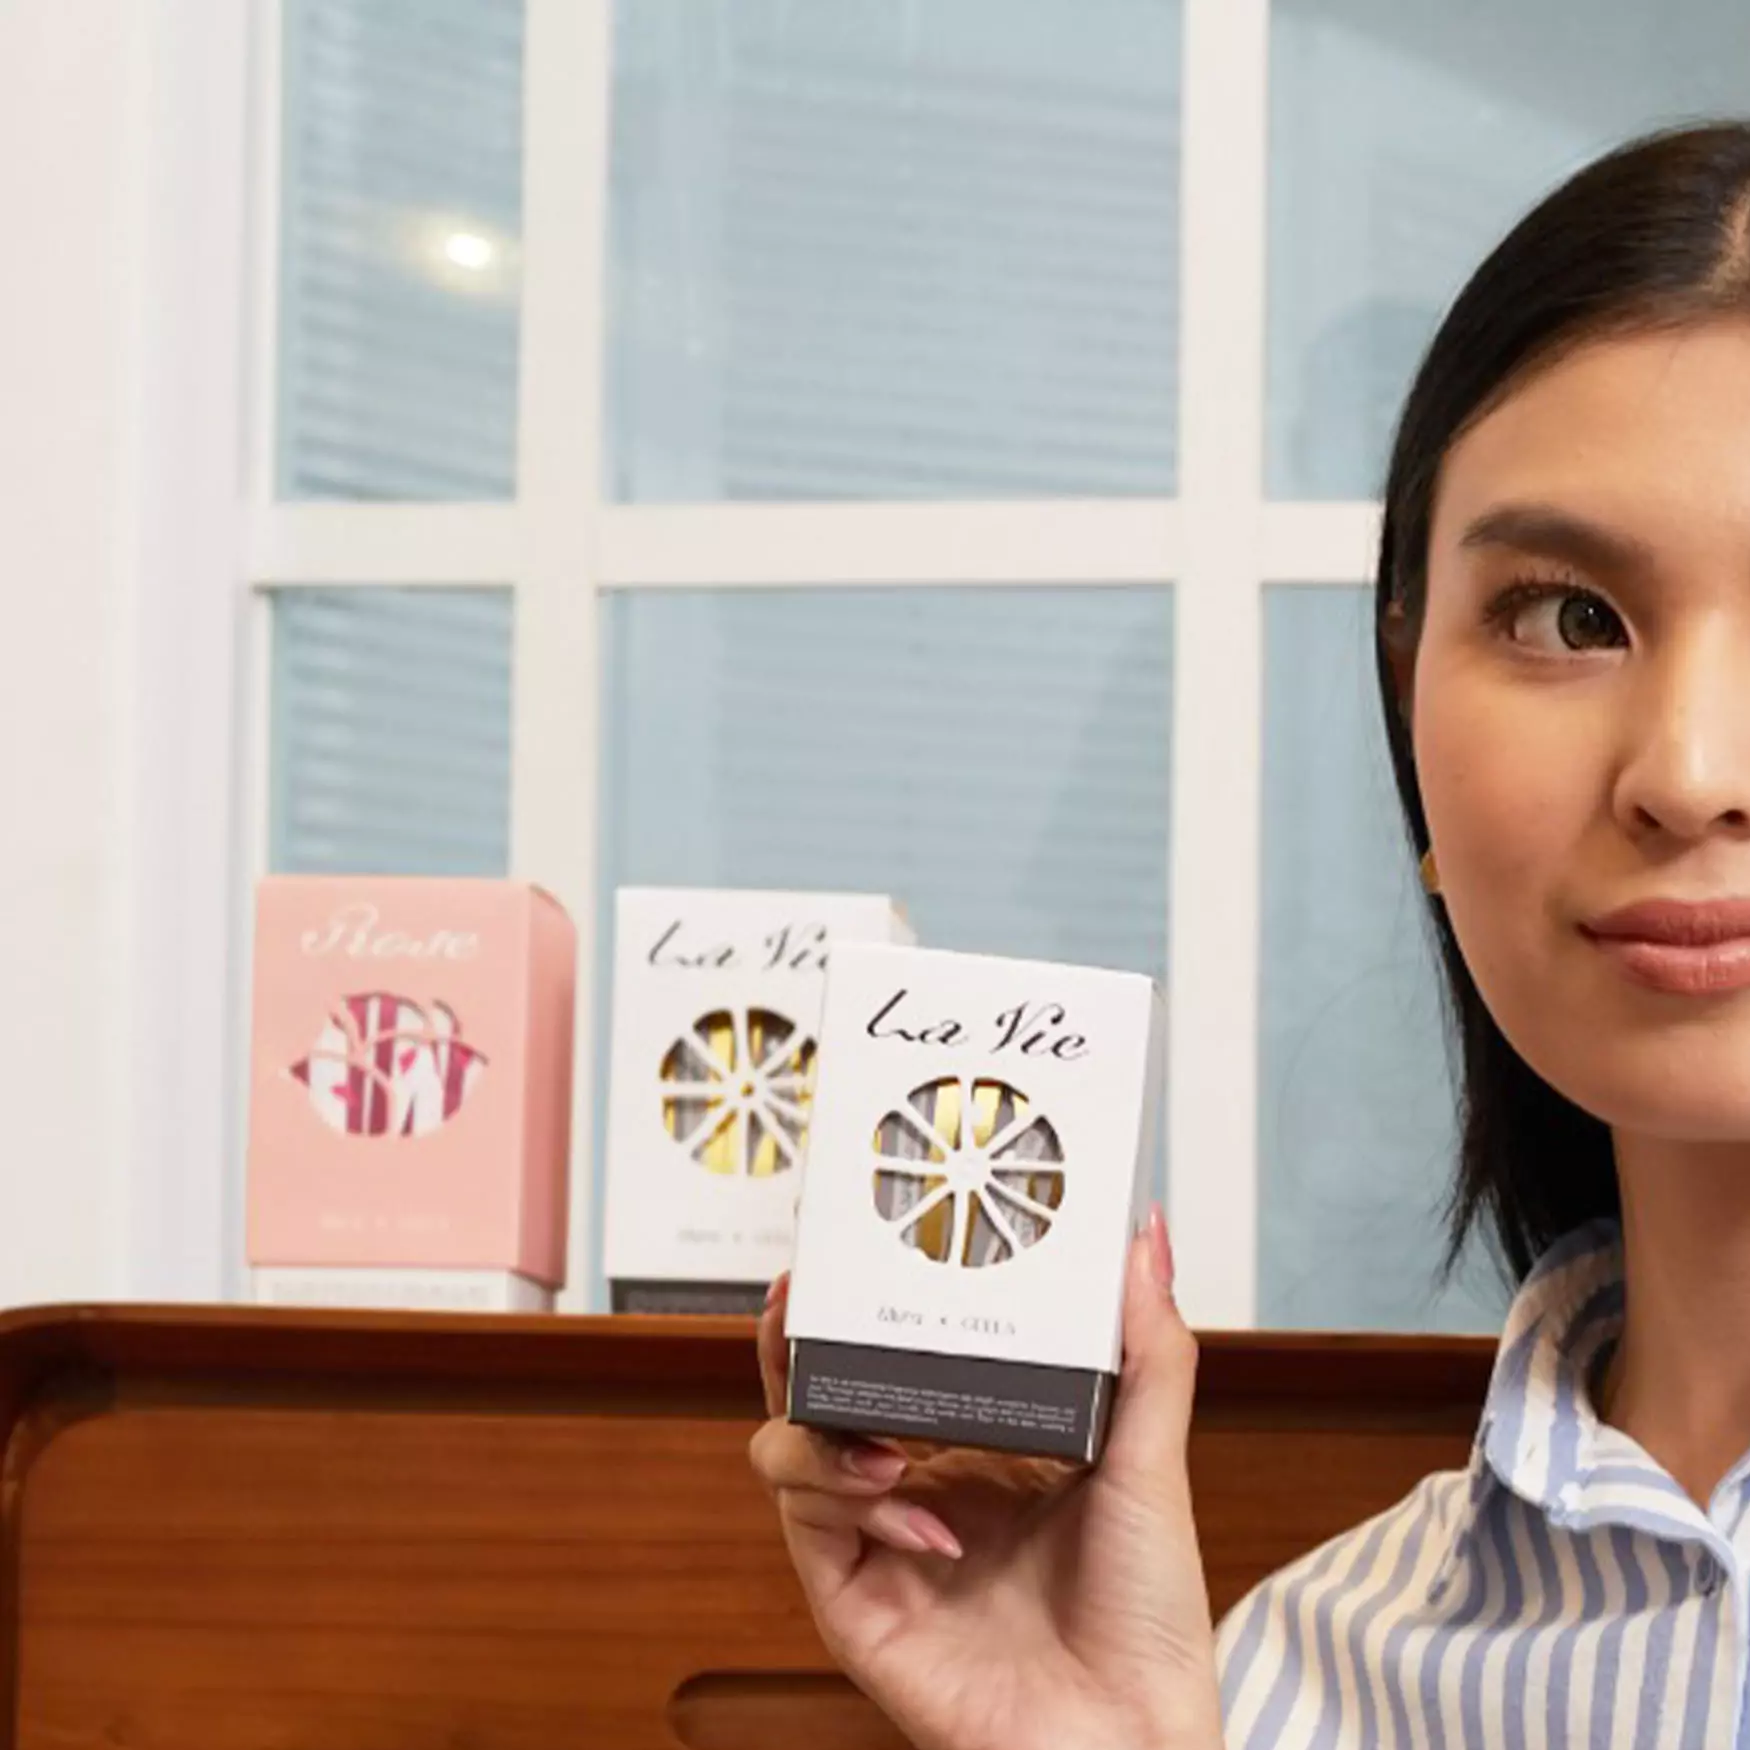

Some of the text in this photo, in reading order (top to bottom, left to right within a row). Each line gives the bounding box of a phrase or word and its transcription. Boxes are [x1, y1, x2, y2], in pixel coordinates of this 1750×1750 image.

[301, 900, 479, 958] Rose
[647, 919, 741, 971] La
[866, 988, 1091, 1061] La Vie
